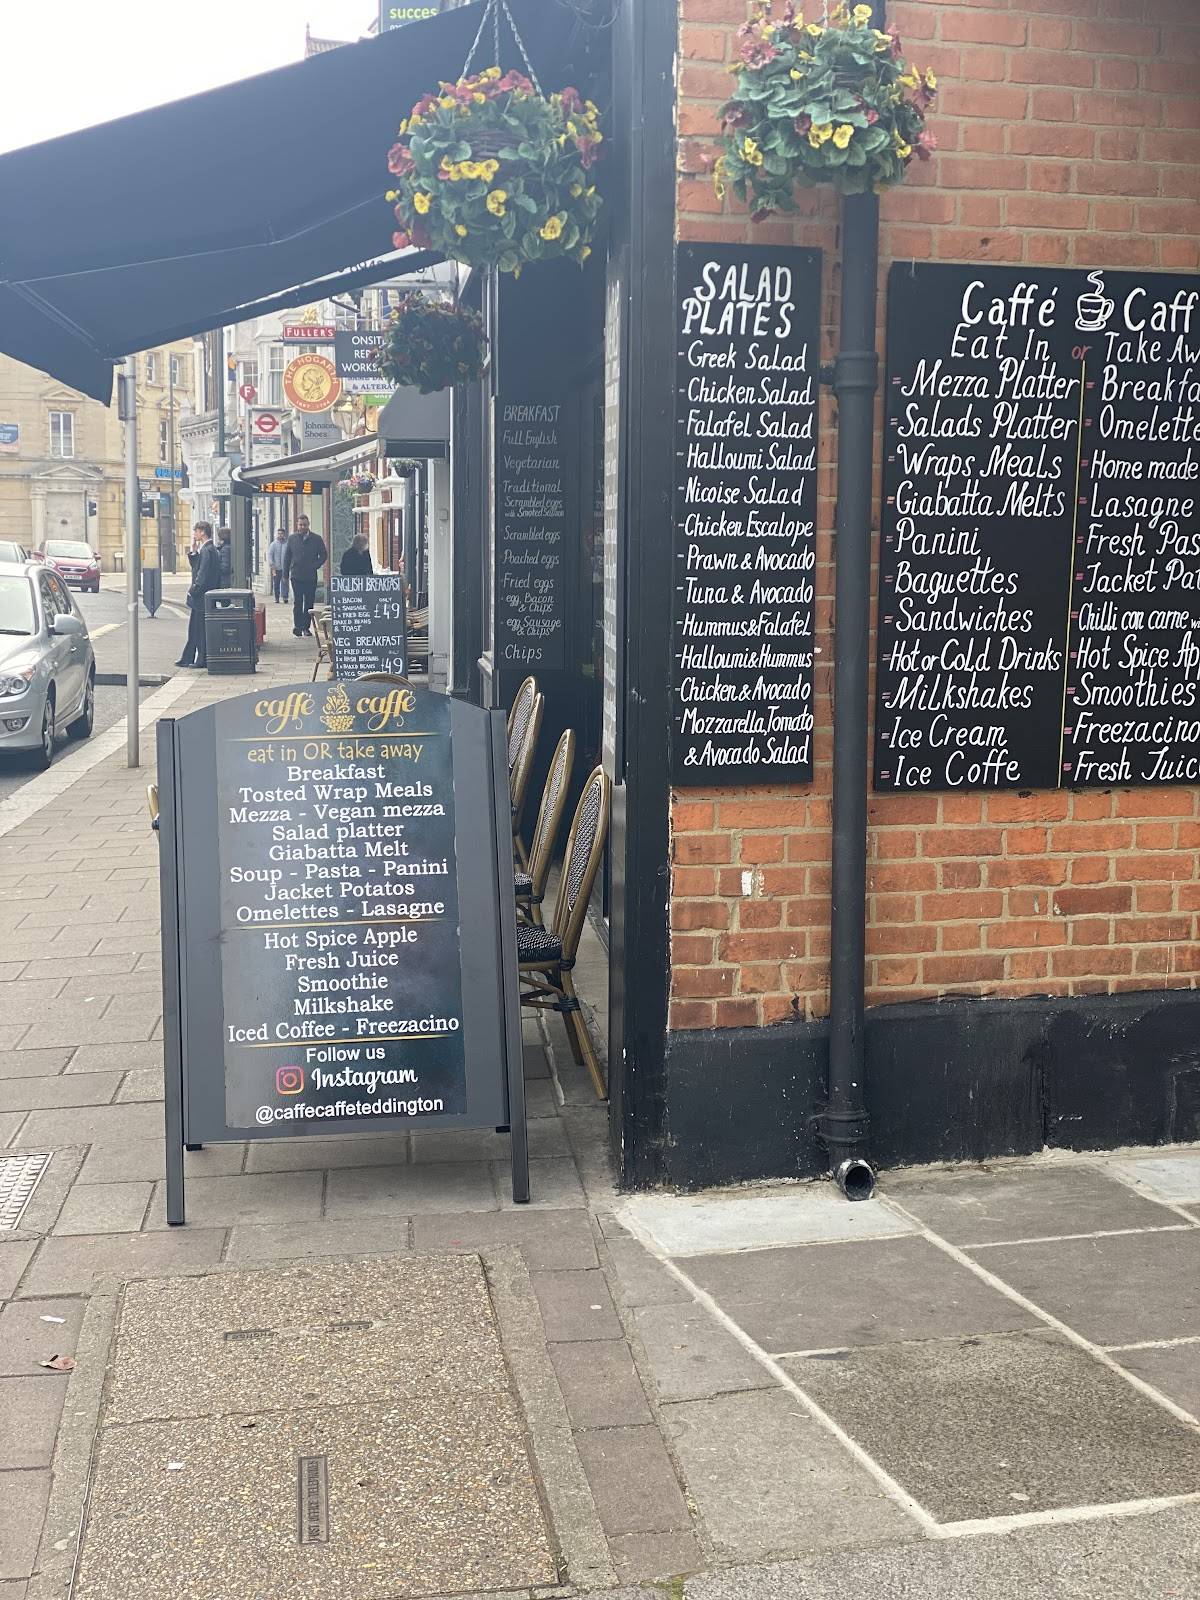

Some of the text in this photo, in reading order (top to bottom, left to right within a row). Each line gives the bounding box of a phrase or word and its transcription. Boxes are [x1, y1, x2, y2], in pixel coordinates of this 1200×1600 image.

[693, 261, 792, 302] SALAD
[962, 281, 1058, 326] Caffé
[286, 327, 334, 337] FULLER'S
[682, 298, 795, 338] PLATES
[688, 340, 807, 371] Greek Salad
[951, 322, 1050, 361] Eat In
[1072, 345, 1092, 360] or
[1105, 331, 1161, 363] Take
[285, 356, 338, 384] THE HOGARTH
[901, 356, 1080, 399] Mezza Platter
[688, 375, 815, 405] Chicken Salad
[504, 405, 561, 422] BREAKFAST
[687, 409, 813, 438] Falafel Salad
[898, 400, 1077, 440] Salads Platter
[503, 430, 557, 448] Full English
[504, 454, 560, 474] Vegetarian
[687, 442, 816, 471] Halloumi Salad
[897, 443, 1062, 488] Wraps Meals
[1091, 448, 1199, 480] Home made
[504, 478, 563, 493] Traditional
[685, 476, 804, 506] Nicoise Salad
[897, 479, 1065, 517] Giabatta Melts
[1091, 482, 1193, 528] Lasagne
[504, 525, 560, 544] Scrambled eggs
[685, 510, 813, 547] Chicken Escalope
[894, 517, 981, 555] Panini
[1086, 523, 1145, 556] Fresh
[502, 549, 559, 569] Poached eggs
[687, 544, 815, 571] Prawn & Avocado
[331, 577, 400, 591] ENGLISH BREAKFAST
[504, 572, 554, 593] Fried eggs
[895, 556, 1018, 604] Baguettes
[1083, 558, 1158, 593] Jacket
[525, 593, 554, 604] Bacon
[686, 577, 813, 604] Tuna & Avocado
[529, 601, 553, 615] Chips
[896, 597, 1033, 632] Sandwiches
[1079, 601, 1189, 631] Chilli con carne
[524, 616, 561, 631] Sausage
[333, 635, 402, 646] VEG BREAKFAST
[505, 644, 542, 663] Chips
[941, 637, 991, 672] Cold
[998, 636, 1062, 671] Drinks
[1076, 634, 1169, 676] Hot Spice
[752, 673, 811, 700] Avocado
[885, 672, 1033, 710] Milkshakes
[1073, 669, 1197, 707] Smoothies
[889, 714, 1007, 748] Ice Cream
[248, 741, 423, 763] eat in OR take away
[684, 735, 809, 766] & Avocado Salad
[1074, 746, 1200, 781] Fresh Juic
[287, 764, 385, 782] Breakfast
[894, 749, 1020, 786] Ice Coffe
[239, 781, 433, 802] Tosted Wrap Meals
[230, 803, 445, 823] Mezza Vegan mezza
[273, 823, 403, 842] Salad platter
[269, 842, 408, 861] Giabatta Melt
[230, 859, 448, 883] Soup Pasta Panini
[265, 882, 415, 901] Jacket Potatos
[237, 901, 445, 922] Omelettes Lasagne
[264, 926, 418, 950] Hot Spice Apple
[286, 951, 399, 971] Fresh Juice
[298, 972, 388, 993] Smoothie
[294, 995, 394, 1016] Milkshake
[228, 1015, 459, 1043] Iced Coffee Freezacino
[306, 1047, 385, 1062] Follow us
[311, 1066, 418, 1094] Instagram
[255, 1098, 443, 1125] @caffecaffeteddington
